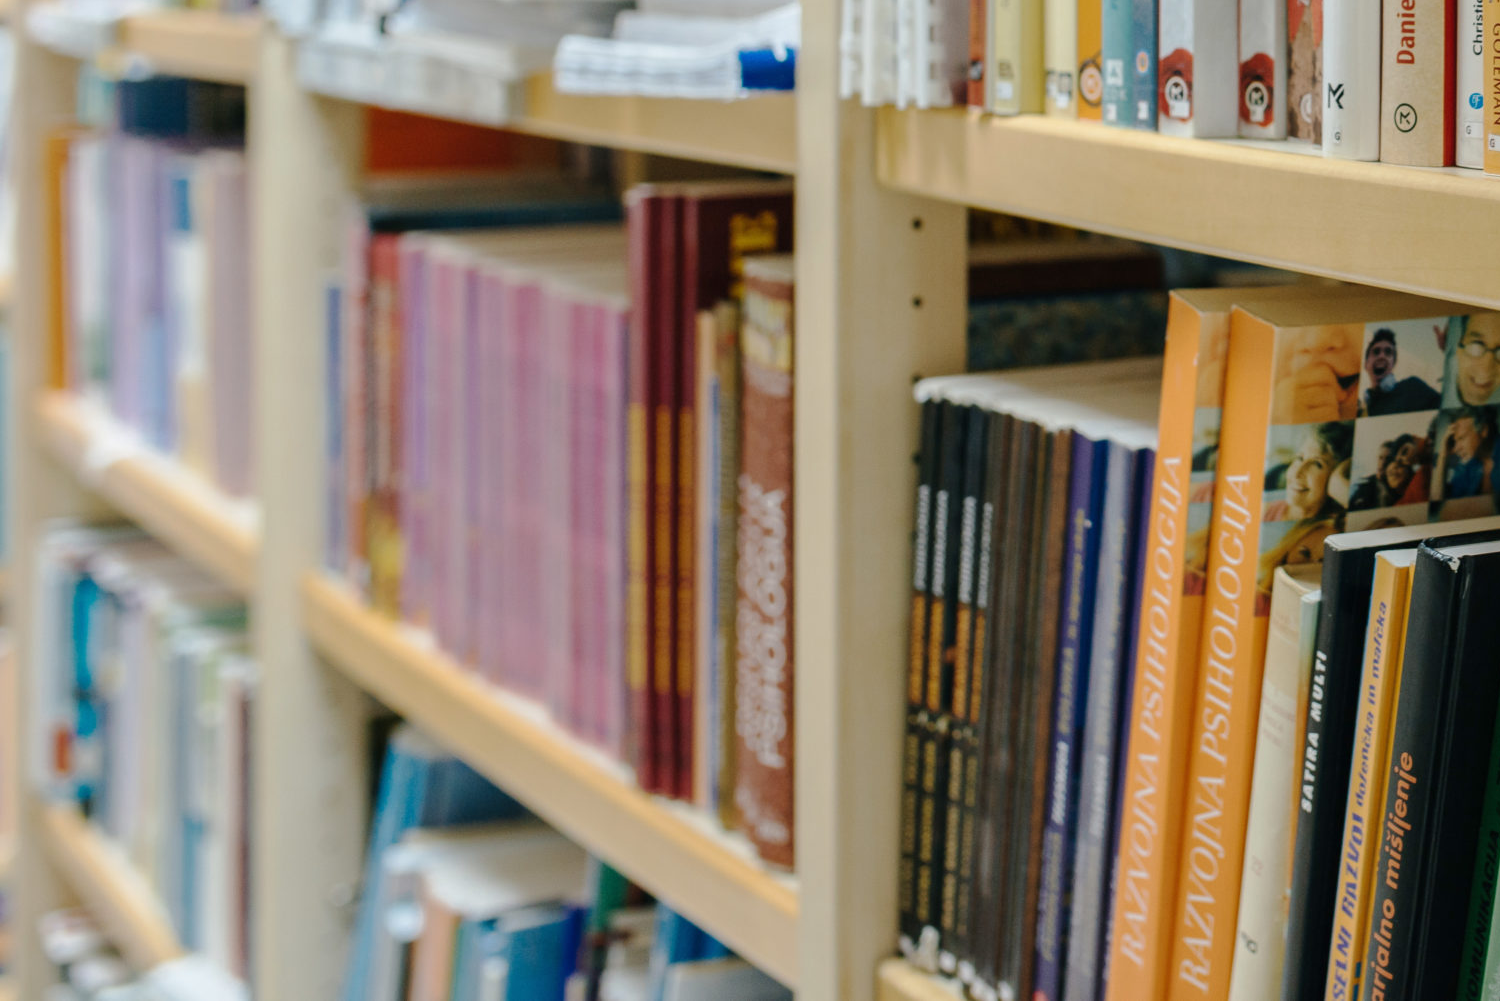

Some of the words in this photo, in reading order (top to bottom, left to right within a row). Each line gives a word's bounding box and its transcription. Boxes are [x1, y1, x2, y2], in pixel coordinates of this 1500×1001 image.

[1136, 455, 1184, 743] PSIHOLOGIJA
[1199, 470, 1253, 768] PSIHOLOGIJA
[1308, 649, 1329, 722] MULTI
[1119, 752, 1163, 969] RAZVOJNA
[1300, 731, 1321, 813] SATIRA
[1382, 750, 1417, 890] mišljenje
[1179, 776, 1228, 994] RAZVOJNA
